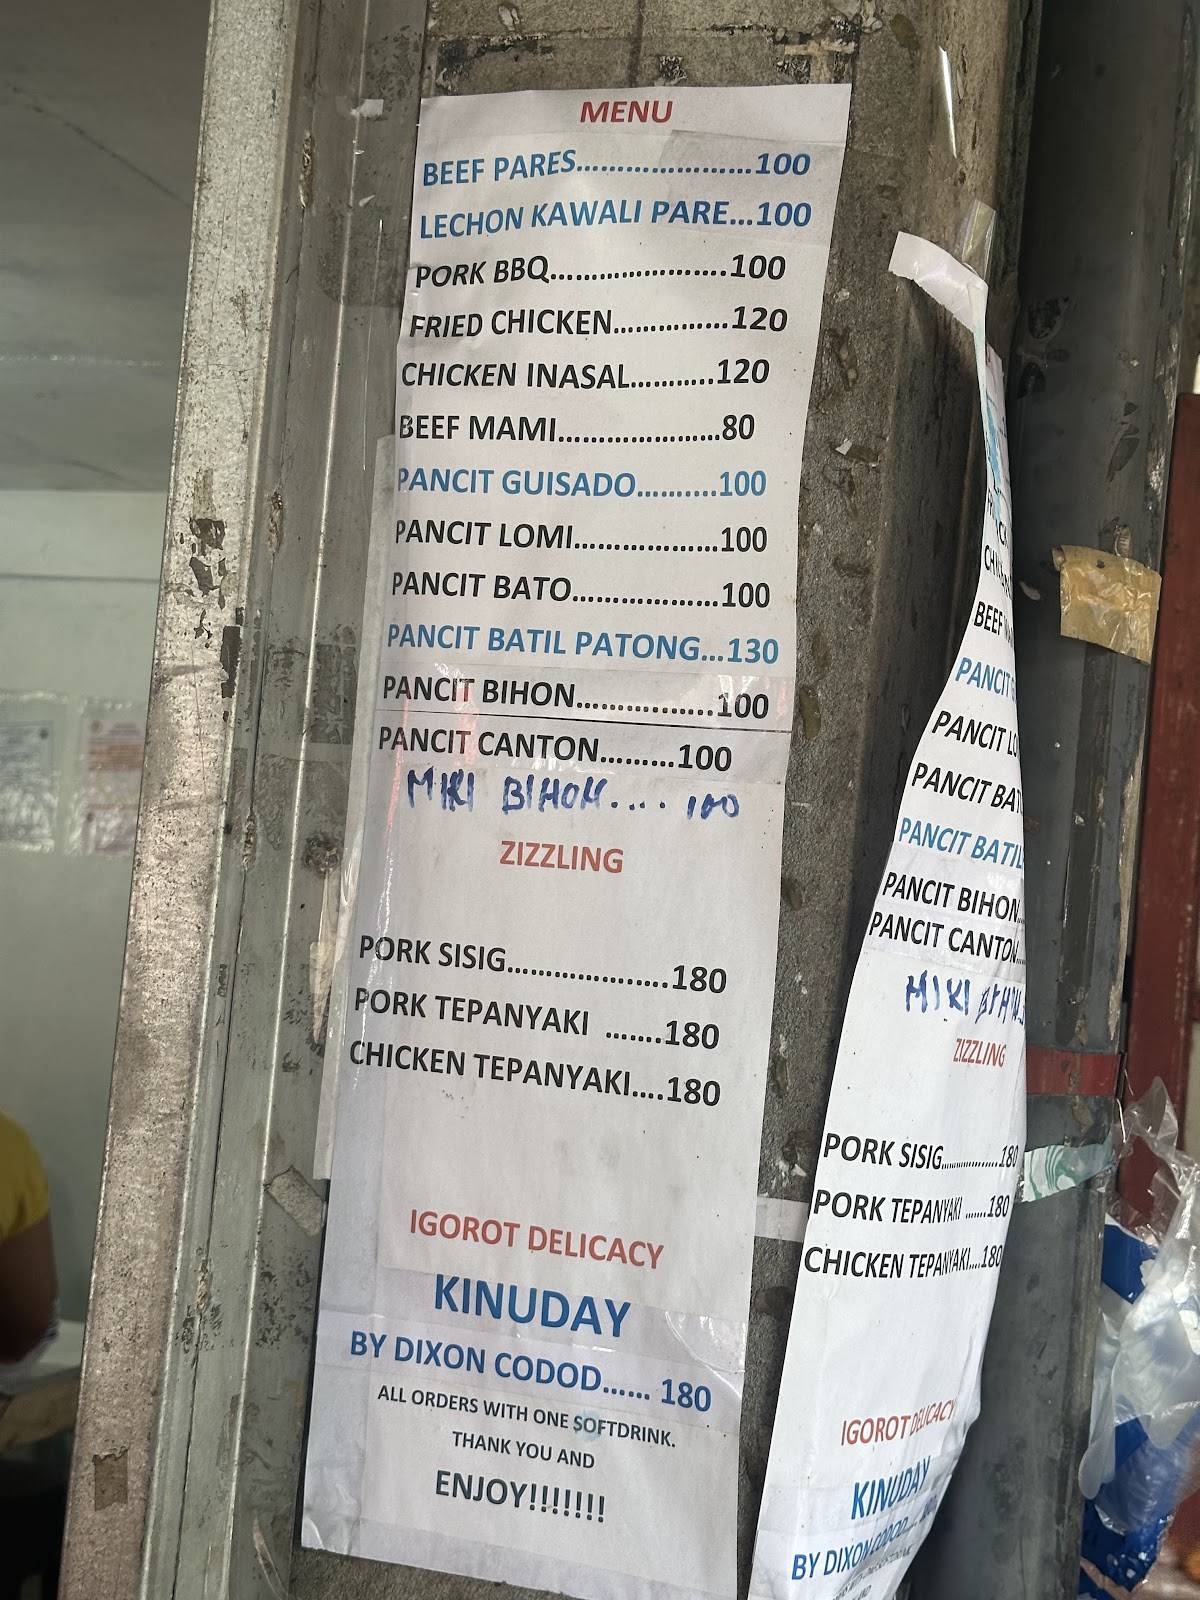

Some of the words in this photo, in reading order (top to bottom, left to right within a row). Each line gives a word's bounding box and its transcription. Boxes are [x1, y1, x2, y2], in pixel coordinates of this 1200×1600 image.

[580, 100, 672, 123] MENU
[422, 158, 485, 186] BEEF
[420, 207, 523, 239] LECHON
[531, 199, 641, 228] KAWALI
[415, 261, 486, 288] PORK
[409, 313, 483, 338] FRIED
[401, 362, 517, 387] CHICKEN
[399, 415, 460, 440] BEEF
[397, 468, 495, 494] PANCIT
[396, 520, 491, 547] PANCIT
[392, 572, 486, 598] PANCIT
[974, 601, 1003, 635] BEEF
[387, 623, 480, 651] PANCIT
[487, 627, 567, 655] BATIL
[383, 675, 475, 702] PANCIT
[955, 657, 1011, 697] PANCIT
[378, 726, 472, 754] PANCIT
[931, 710, 1006, 751] PANCIT
[407, 768, 475, 812] MIKI
[911, 762, 992, 804] PANCIT
[898, 817, 972, 855] PANCIT
[499, 840, 624, 874] ZIZZLING
[882, 871, 955, 909] PANCIT
[868, 911, 946, 949] PANCIT
[359, 935, 431, 965] PORK
[354, 987, 427, 1018] PORK
[434, 995, 590, 1036] TEPANYAKI
[349, 1040, 466, 1076] CHICKEN
[953, 1038, 1006, 1067] ZIZZLING
[823, 1133, 894, 1167] PORK
[813, 1189, 884, 1222] PORK
[891, 1197, 963, 1224] TEPANYAKI
[409, 1209, 520, 1247] IGOROT
[528, 1225, 665, 1270] DELICACY
[804, 1246, 902, 1279] CHICKEN
[434, 1273, 631, 1338] KINUDAY
[350, 1331, 387, 1358] BY
[394, 1336, 486, 1374] DIXON
[660, 1378, 712, 1412] 180
[377, 1385, 407, 1404] ALL
[411, 1390, 479, 1414] ORDERS
[483, 1400, 528, 1422] WITH
[533, 1409, 569, 1429] ONE
[573, 1413, 676, 1448] SOFTDRINK.
[841, 1415, 911, 1446] IGOROT
[452, 1431, 511, 1455] THANK
[516, 1440, 552, 1461] YOU
[557, 1449, 595, 1469] AND
[435, 1470, 605, 1522] ENJOY!!!!!!!
[851, 1455, 930, 1520] KINUDAY
[791, 1552, 820, 1581] BY
[823, 1537, 873, 1576] DIXON
